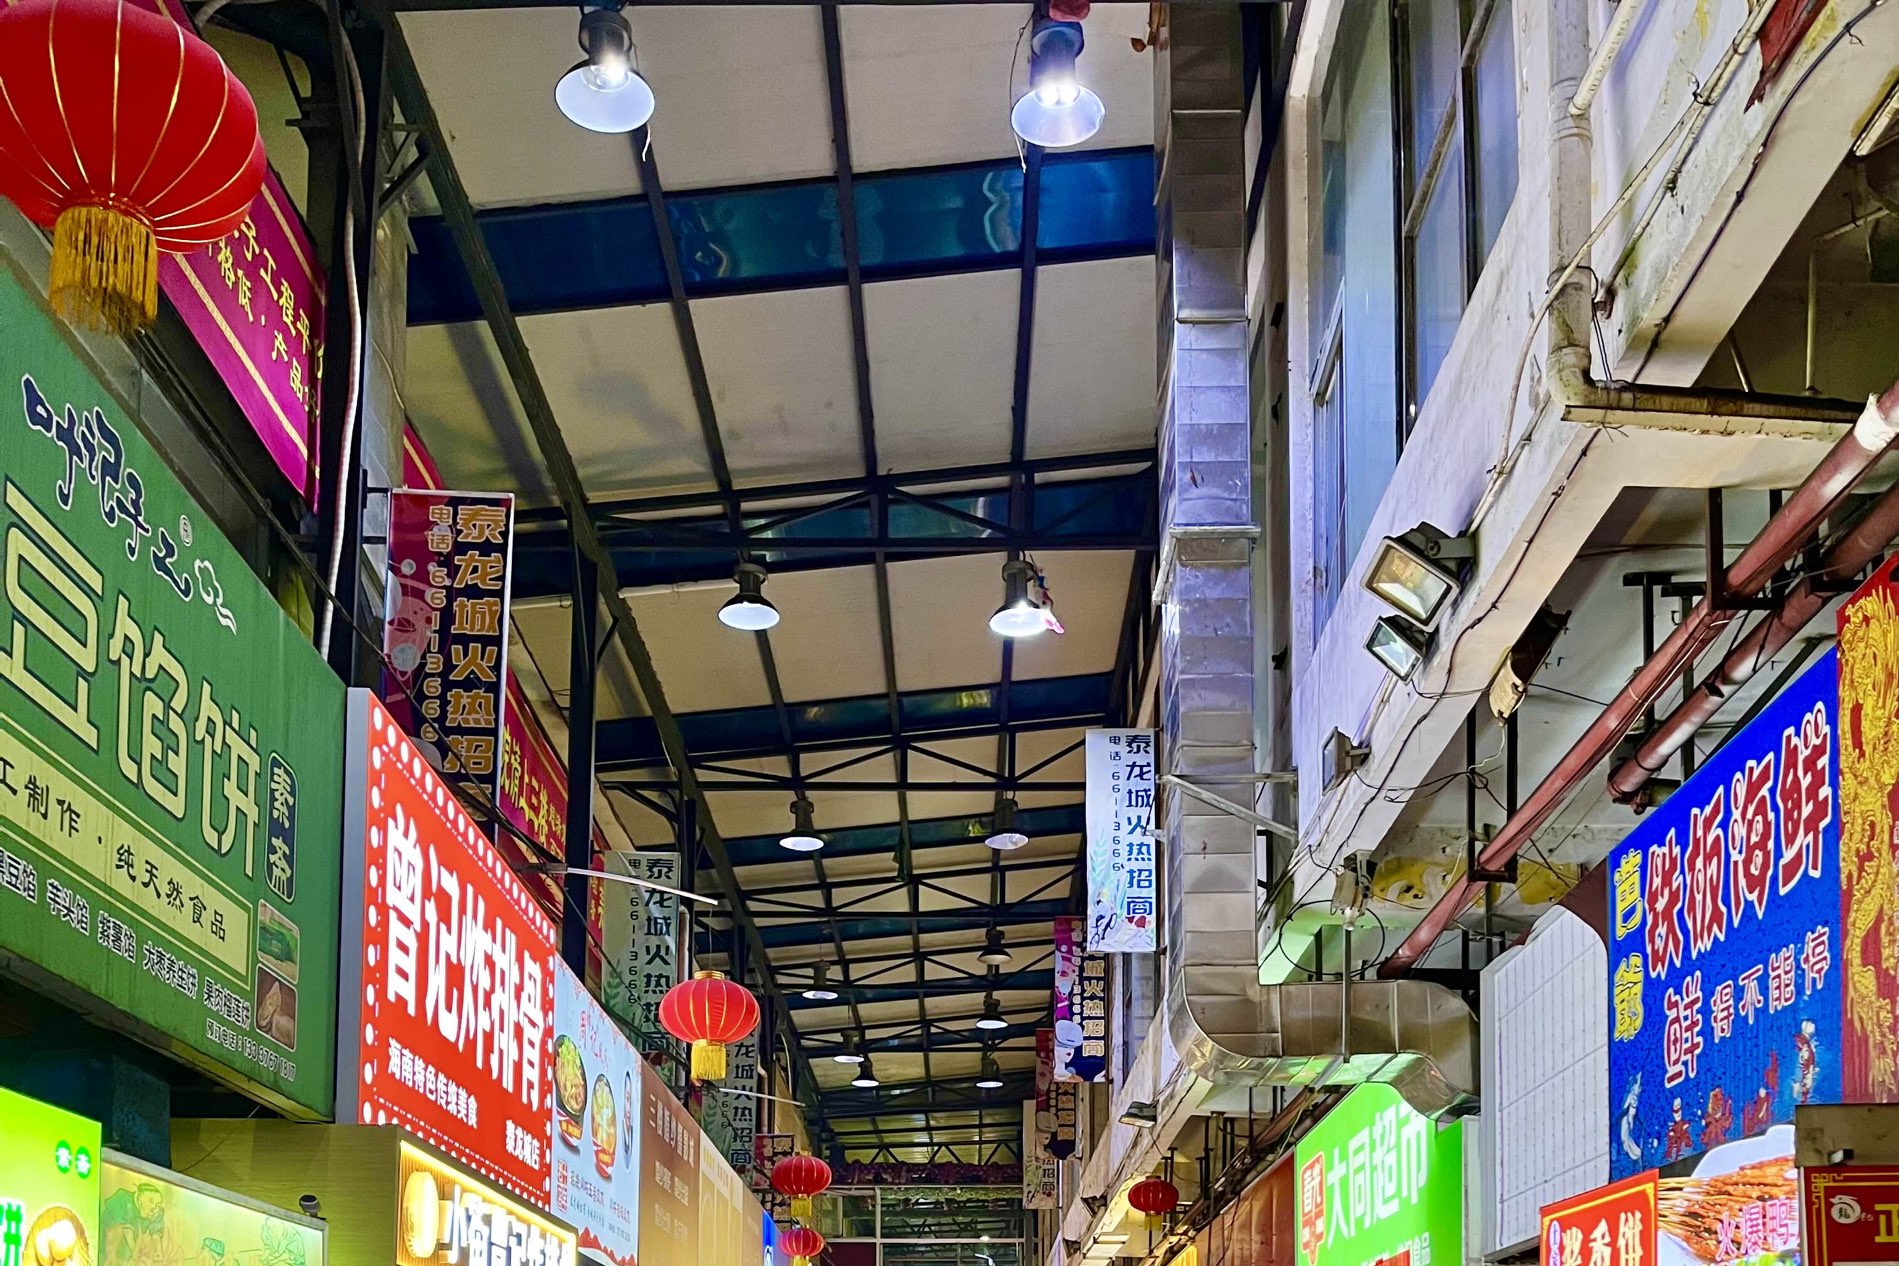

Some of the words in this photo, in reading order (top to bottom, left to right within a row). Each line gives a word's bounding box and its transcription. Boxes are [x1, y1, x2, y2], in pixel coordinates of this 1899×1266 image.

[1125, 734, 1153, 917] 泰龙城火热招商
[1644, 700, 1833, 980] 铁板海鲜
[386, 803, 545, 1114] 曾记炸排骨
[387, 1036, 479, 1131] 海南特色传统美食
[504, 1118, 541, 1171] 泰龙城店
[1326, 1101, 1428, 1249] 大同超市
